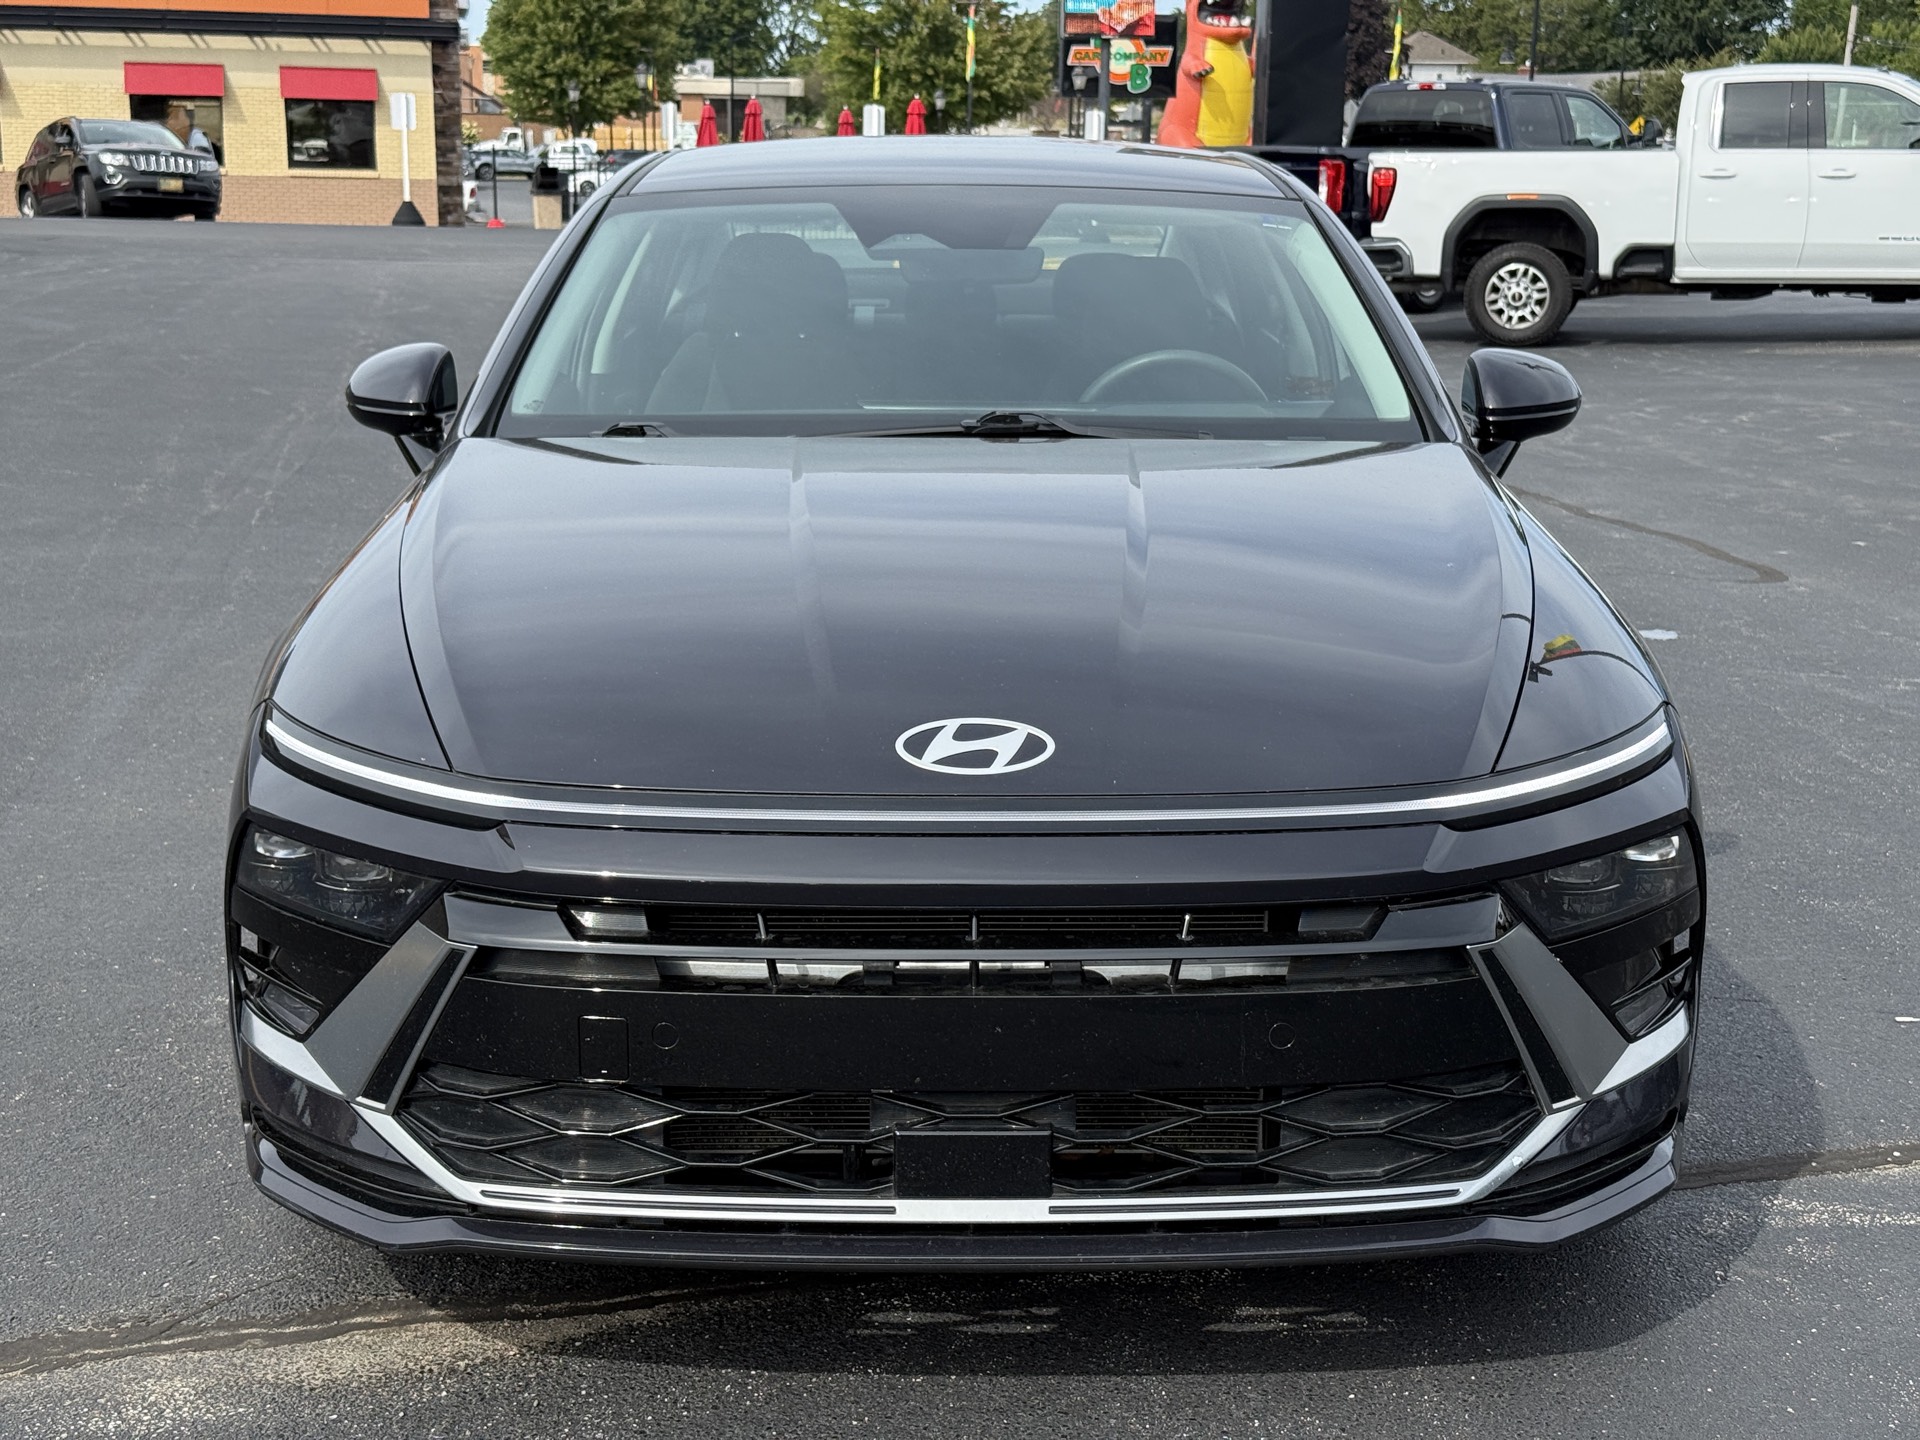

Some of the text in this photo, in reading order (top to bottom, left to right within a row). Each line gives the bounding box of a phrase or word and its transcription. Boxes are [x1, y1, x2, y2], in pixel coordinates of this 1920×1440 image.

[1074, 51, 1167, 62] CAR OMPANY
[1129, 63, 1150, 92] B
